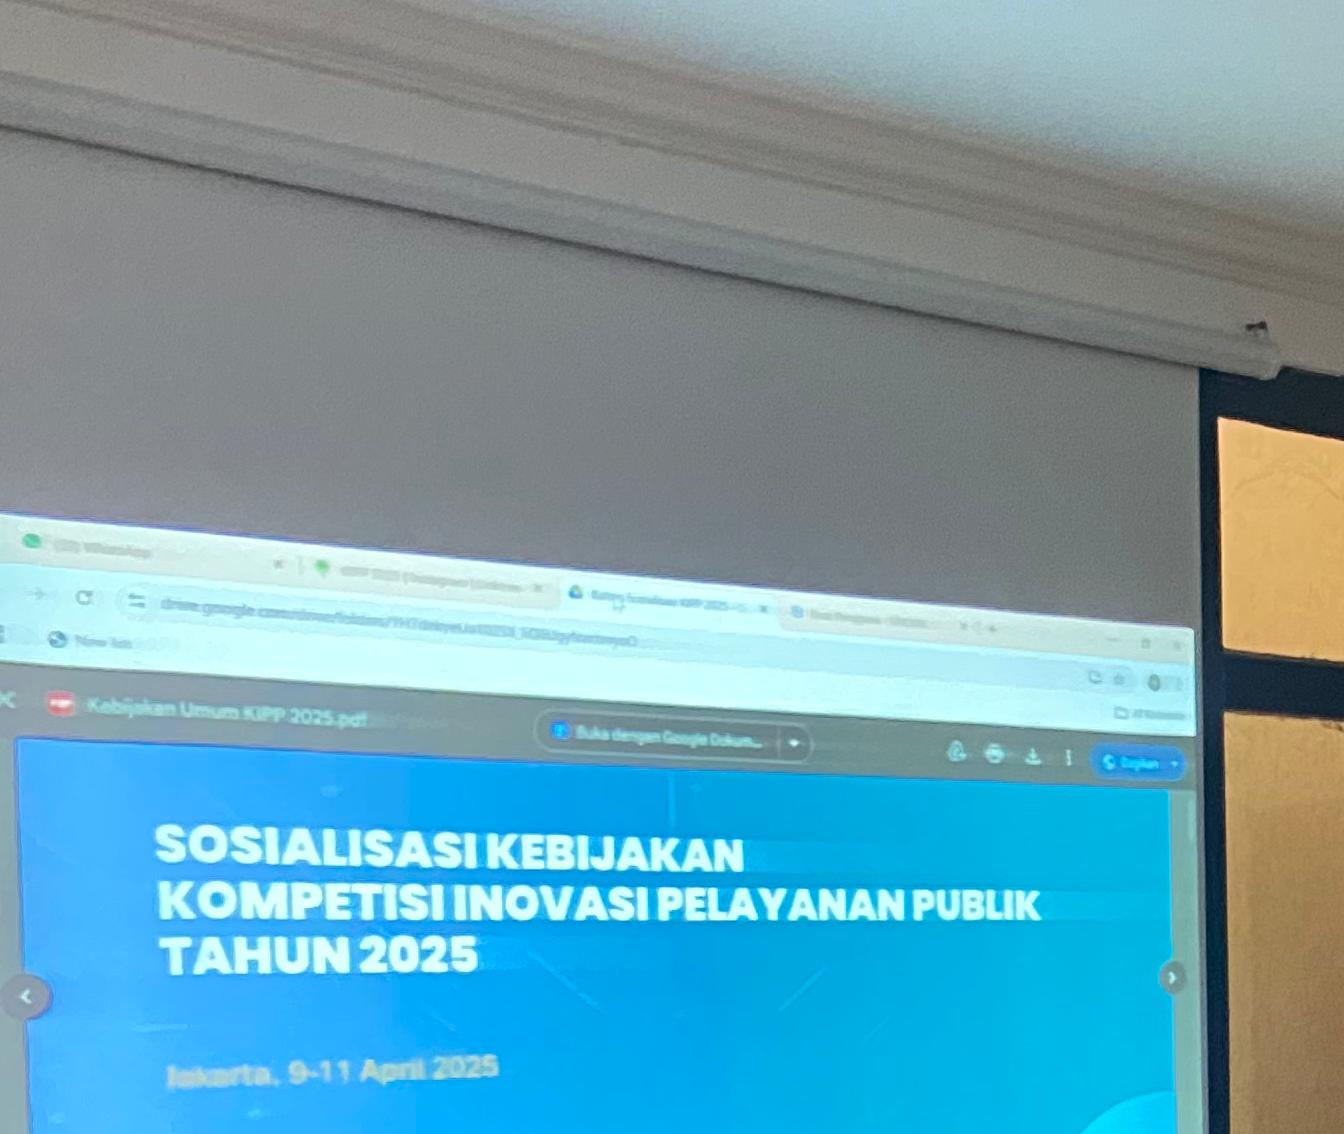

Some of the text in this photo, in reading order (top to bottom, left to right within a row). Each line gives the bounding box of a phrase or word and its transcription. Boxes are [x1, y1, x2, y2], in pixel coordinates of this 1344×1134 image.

[87, 695, 369, 730] Kebijakan Umum KIPP 2025.pdf
[663, 729, 708, 748] Google
[155, 823, 745, 873] SOSIALISASI KEBIJAKAN
[158, 880, 1042, 922] KOMPETISI INOVASI PELAYANAN PUBLIK
[159, 935, 478, 976] TAHUN 2025
[288, 1059, 350, 1085] 9-11
[360, 1058, 427, 1086] April
[432, 1053, 499, 1080] 2025
